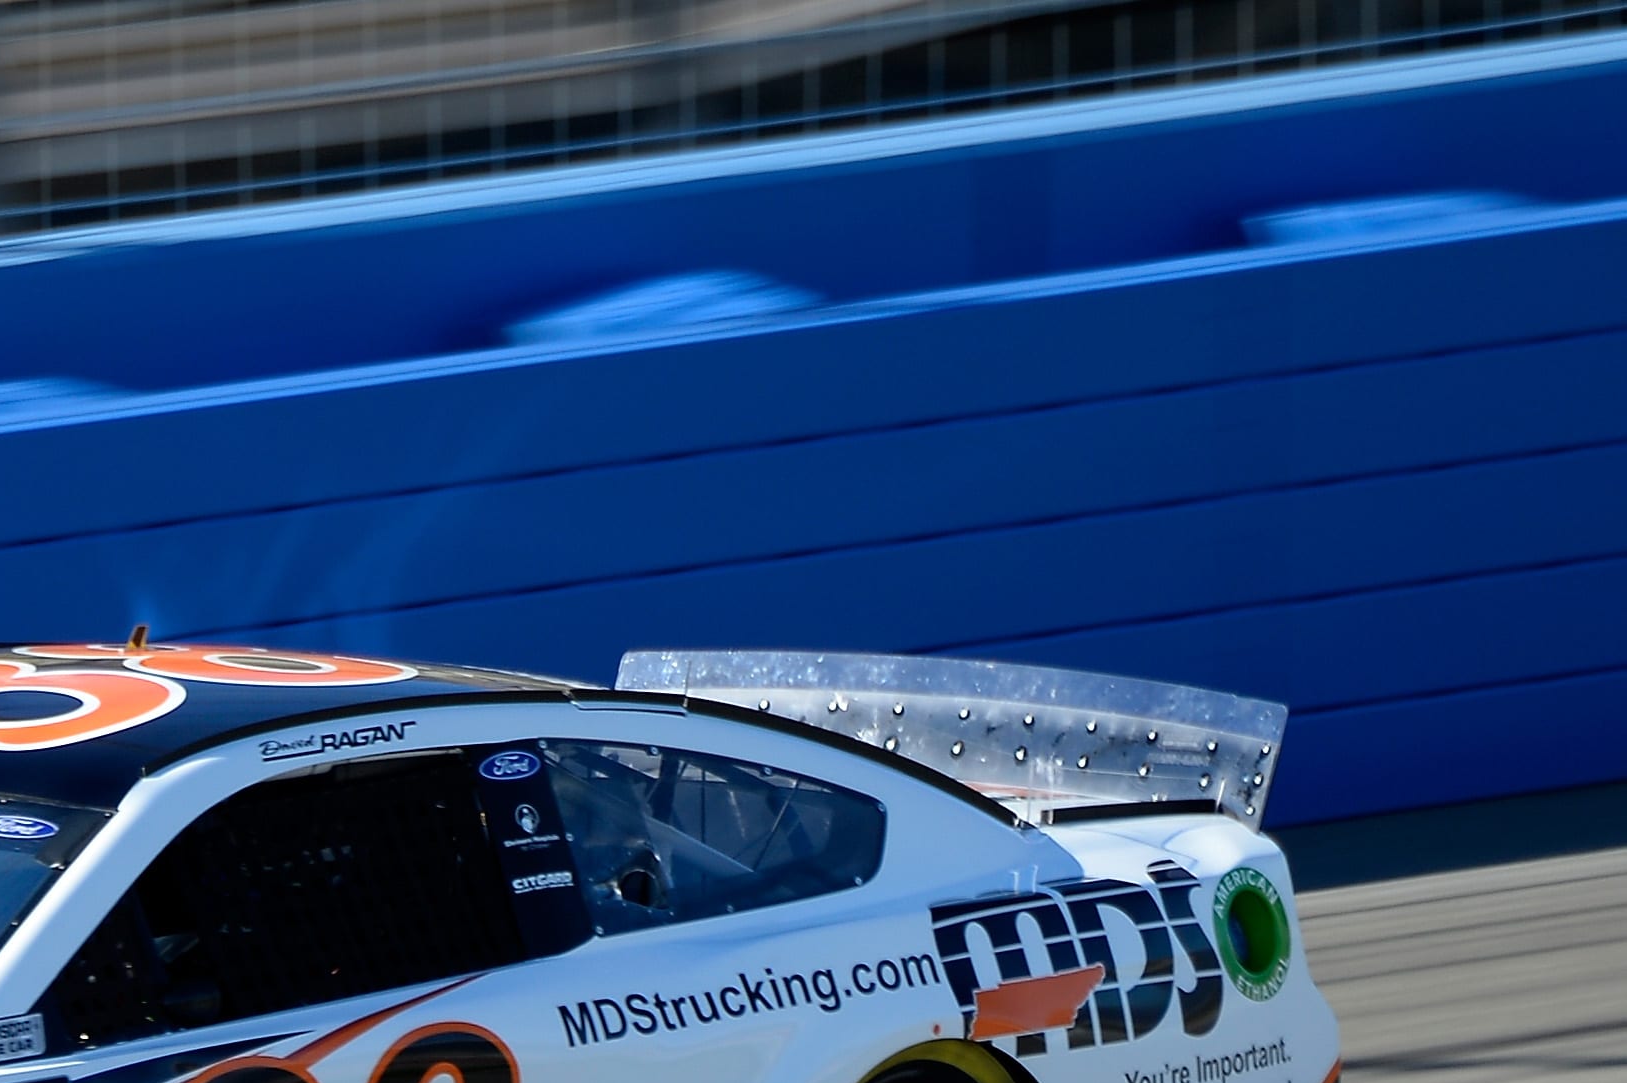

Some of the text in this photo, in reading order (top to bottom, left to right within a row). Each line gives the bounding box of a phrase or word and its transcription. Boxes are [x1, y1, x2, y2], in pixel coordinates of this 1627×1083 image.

[320, 720, 417, 752] RAGAN
[1214, 869, 1279, 920] AMERICAN
[557, 952, 942, 1048] MDStrucking.com
[1236, 957, 1290, 1001] ETHANOL
[7, 1038, 34, 1054] CAR
